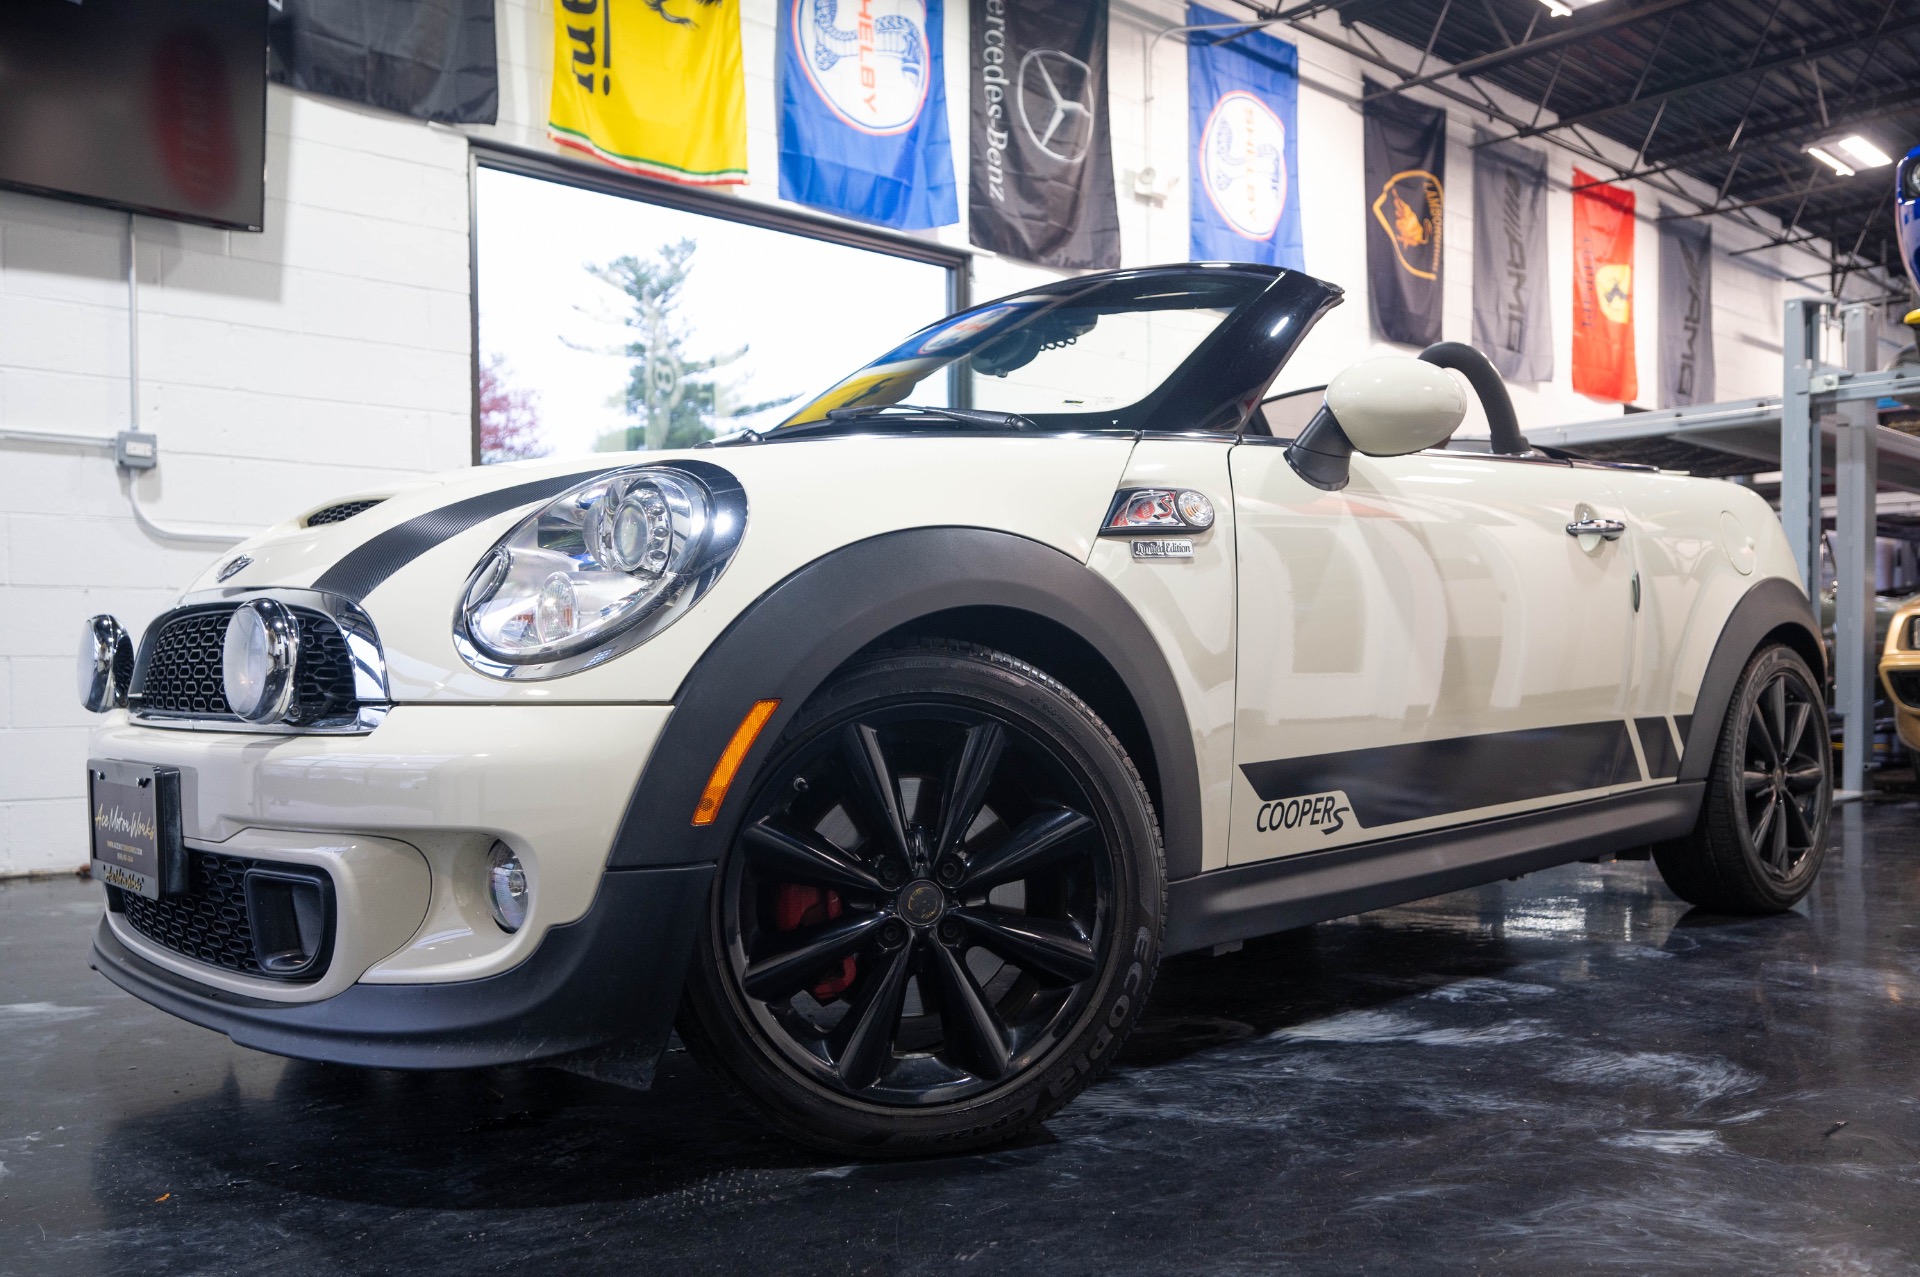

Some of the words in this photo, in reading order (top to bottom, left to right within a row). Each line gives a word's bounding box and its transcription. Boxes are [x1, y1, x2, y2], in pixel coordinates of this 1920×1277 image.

[857, 0, 878, 113] HELBY
[982, 0, 1010, 202] ercedes-Benz
[1165, 542, 1191, 554] Edition
[1256, 796, 1335, 833] COOPER
